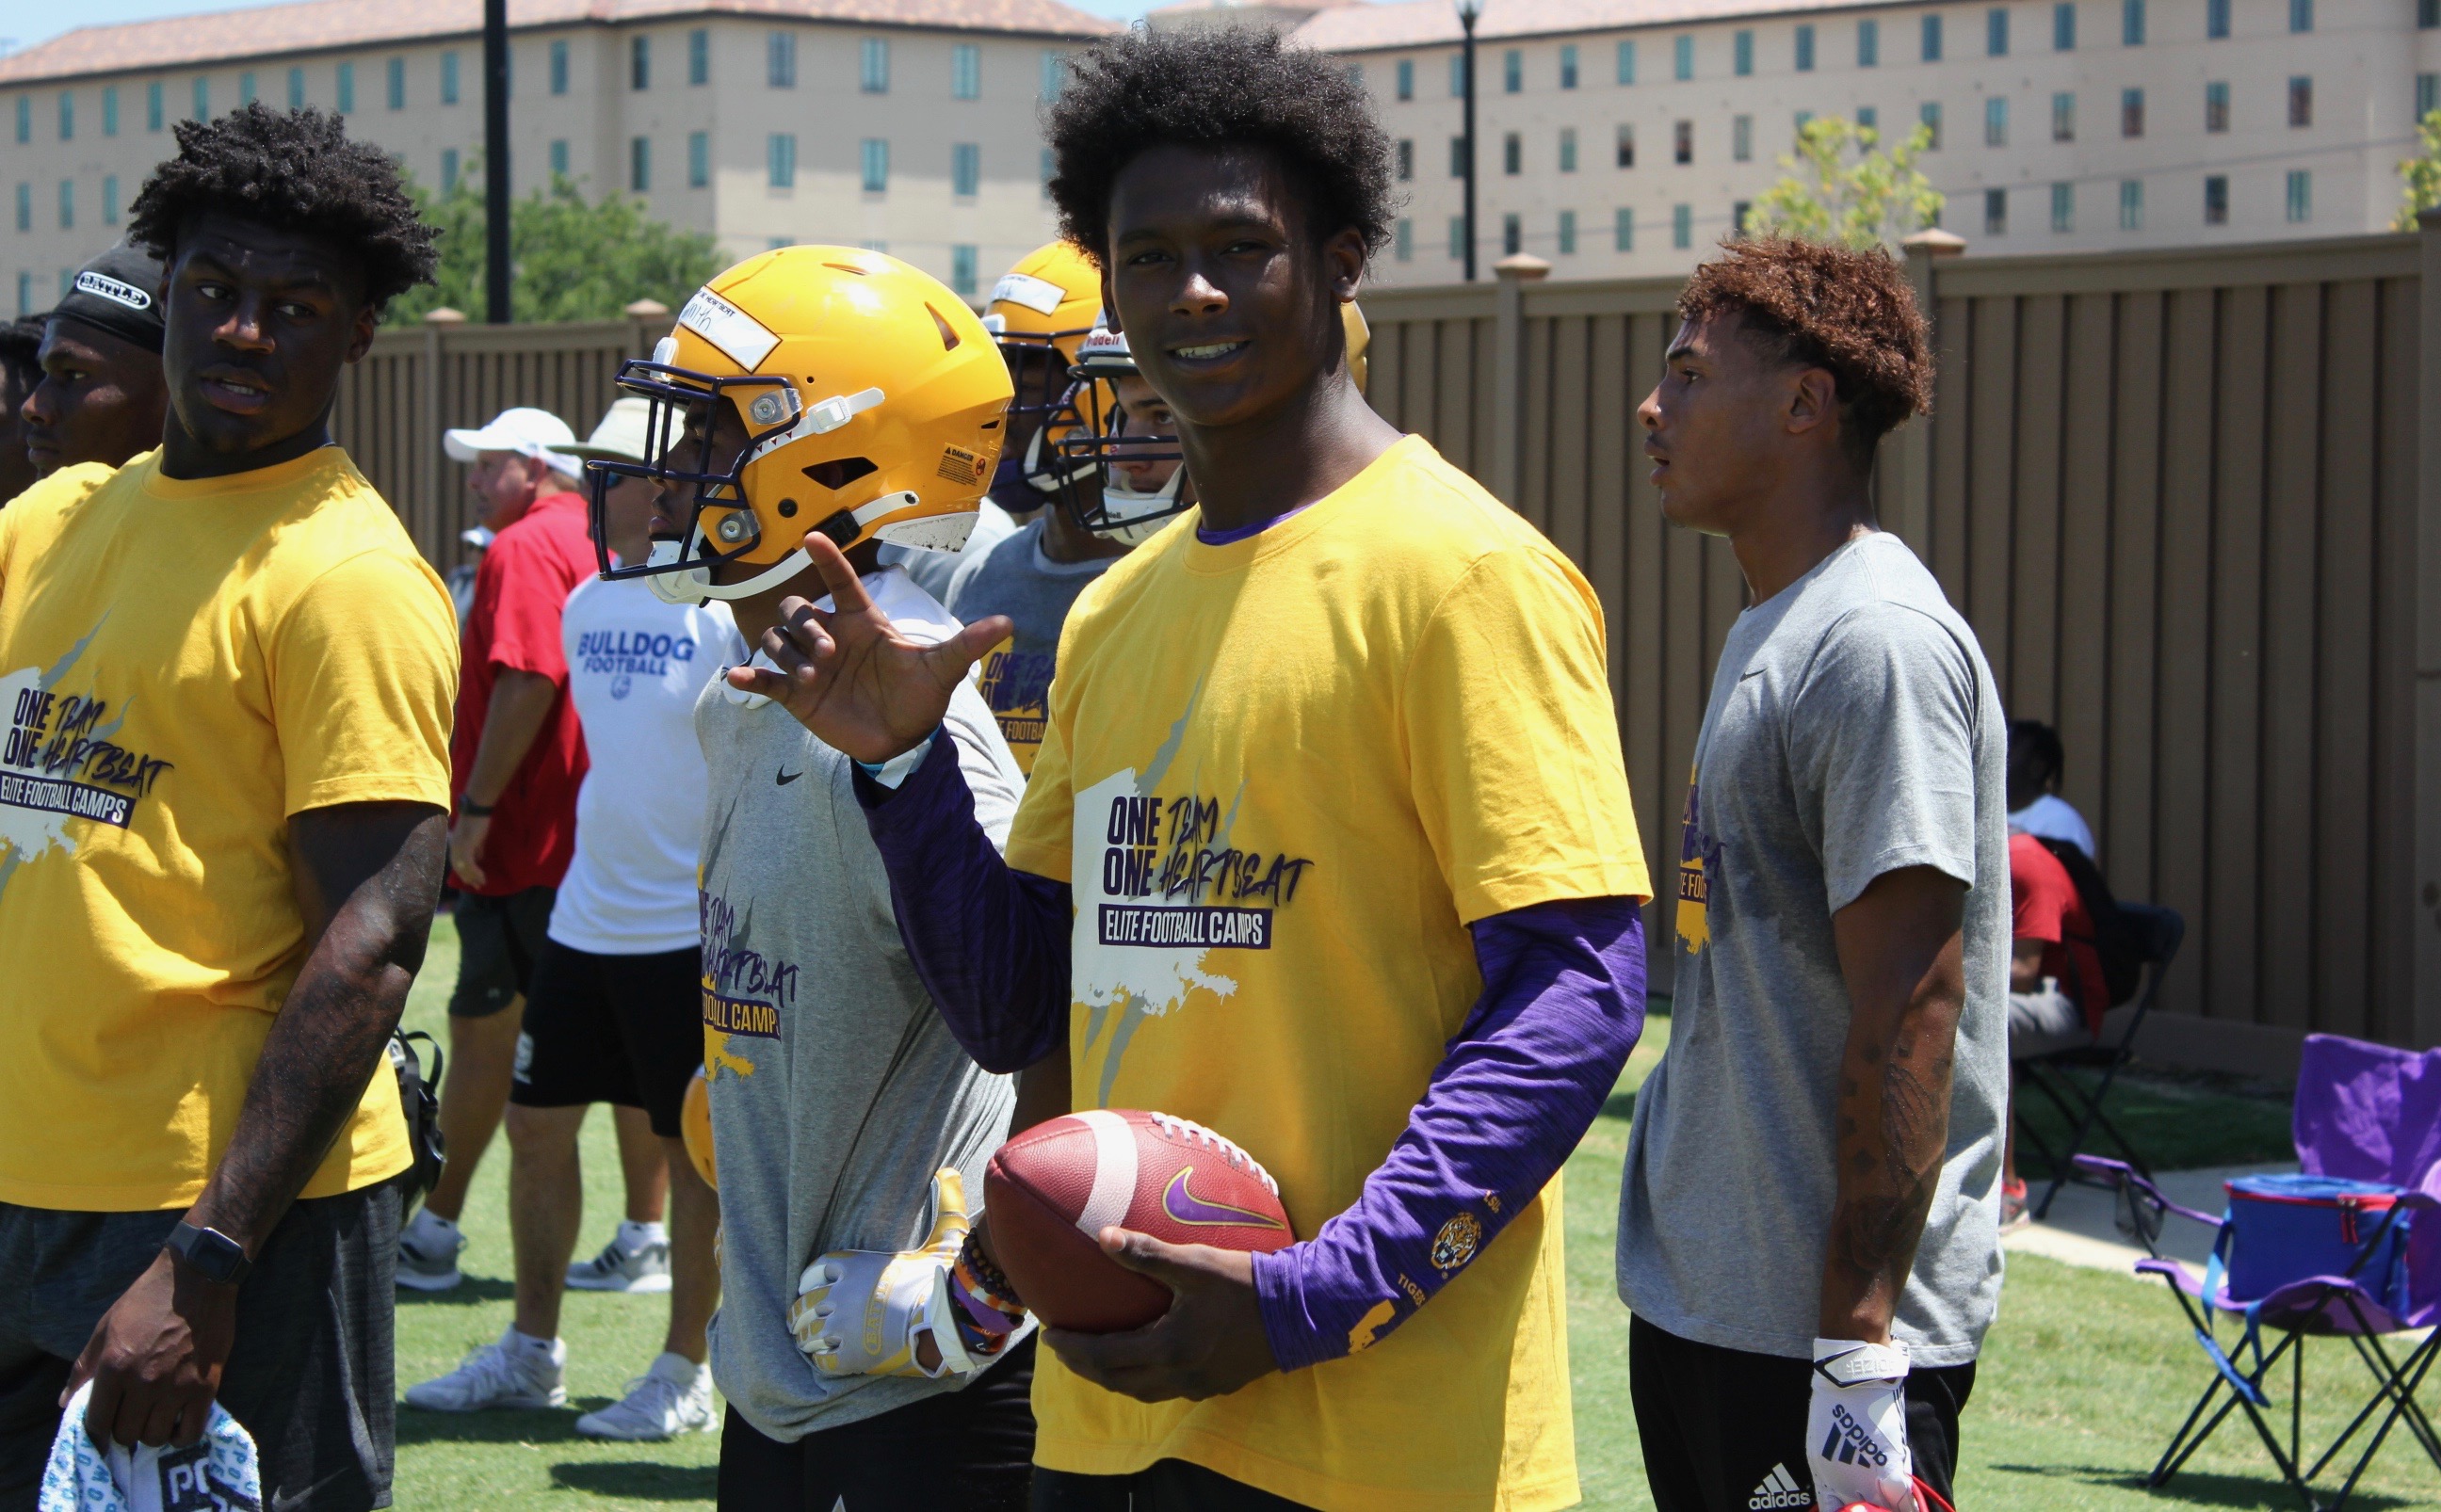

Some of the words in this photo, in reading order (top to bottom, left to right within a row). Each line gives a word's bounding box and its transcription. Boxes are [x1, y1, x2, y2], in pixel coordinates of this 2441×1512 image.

[81, 274, 143, 305] BATTLE
[951, 449, 974, 462] DANGER
[577, 631, 695, 661] BULLDOG
[584, 657, 668, 675] FOOTBALL
[13, 687, 56, 730] ONE
[58, 696, 106, 734] TEAM
[1006, 720, 1047, 741] FOOTBA
[3, 727, 43, 768] ONE
[42, 732, 175, 798] HEARTBEAT
[1, 774, 24, 801] ELITE
[24, 780, 73, 811] FOOTBALL
[72, 787, 127, 824] CAMPS
[1107, 796, 1163, 846] ONE
[1167, 796, 1219, 846] TEAM
[1103, 846, 1157, 896] ONE
[1158, 847, 1315, 907] HEARTBEAT
[1105, 909, 1140, 941] ELITE
[1140, 910, 1205, 943] FOOTBALL
[1209, 911, 1263, 945] CAMPS
[1832, 1403, 1888, 1467] adidas
[1748, 1490, 1811, 1510] adidas
